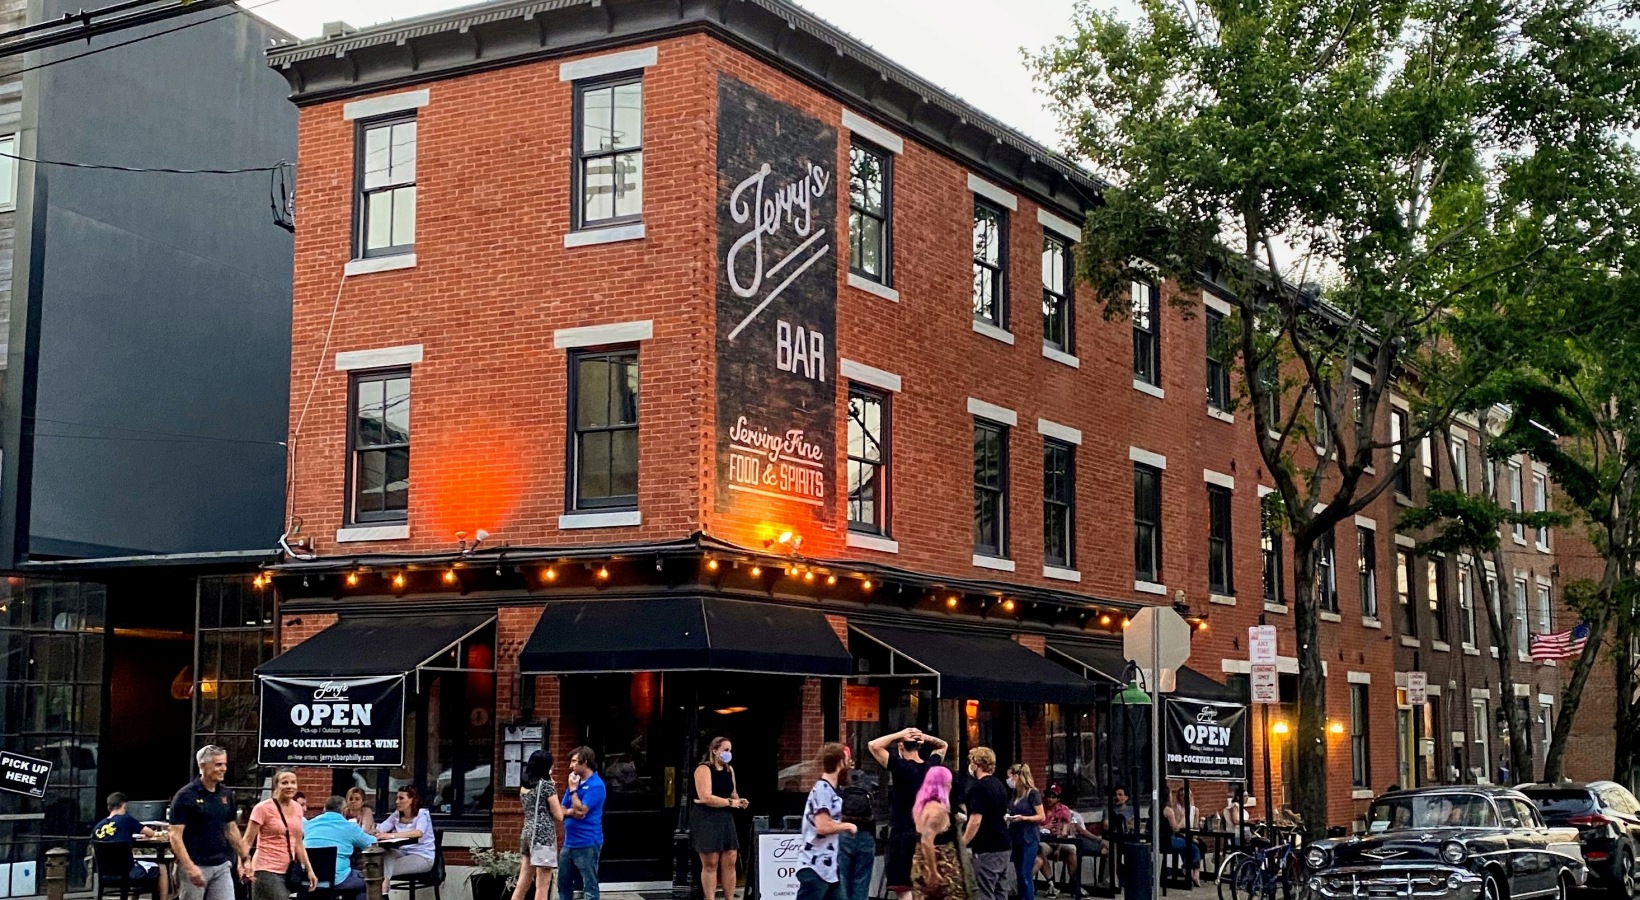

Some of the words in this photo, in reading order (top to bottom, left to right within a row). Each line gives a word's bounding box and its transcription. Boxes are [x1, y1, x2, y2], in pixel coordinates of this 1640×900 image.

[727, 162, 830, 298] Jerry's
[776, 319, 825, 382] BAR
[729, 415, 783, 462] Serving
[783, 429, 823, 460] Fine
[729, 453, 760, 486] FOOD
[762, 463, 778, 486] &
[780, 463, 824, 498] SPIRITS
[313, 680, 349, 699] Jerry's
[290, 703, 373, 726] OPEN
[342, 727, 361, 735] Seating
[1183, 724, 1231, 746] OPEN
[2, 757, 30, 770] PICK
[32, 764, 48, 774] UP
[6, 771, 37, 785] HERE
[773, 838, 802, 859] Jerr
[777, 867, 796, 879] OP
